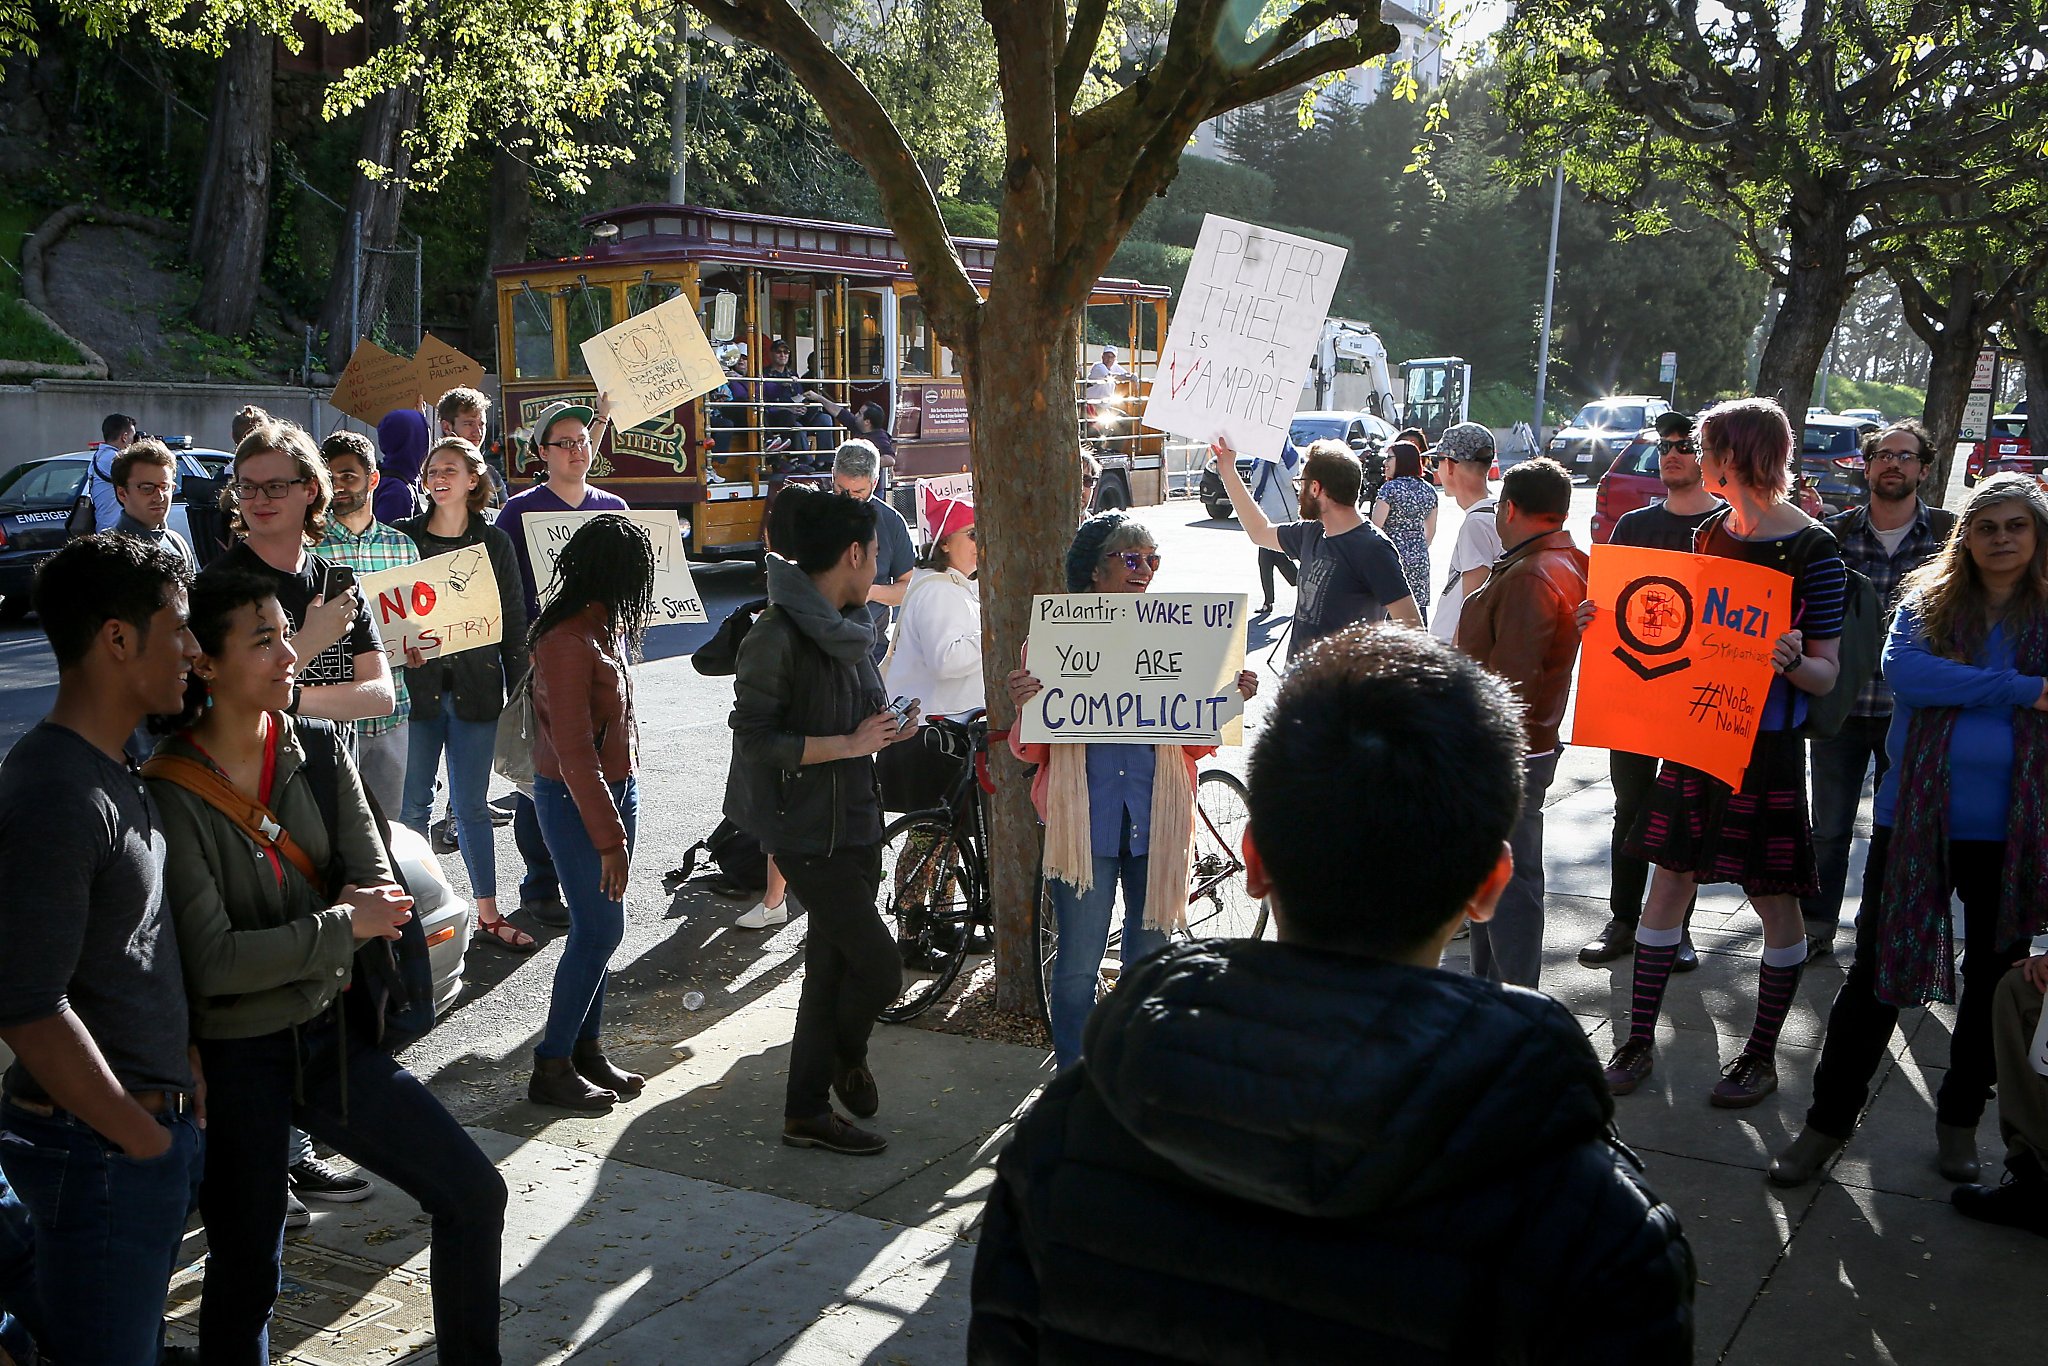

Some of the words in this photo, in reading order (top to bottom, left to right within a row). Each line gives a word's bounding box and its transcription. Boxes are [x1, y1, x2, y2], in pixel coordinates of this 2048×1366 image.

[1211, 230, 1324, 304] PETER
[1200, 283, 1290, 348] THIEL
[427, 355, 454, 368] ICE
[1189, 332, 1208, 349] IS
[1261, 350, 1275, 368] A
[430, 365, 470, 380] PALANTIR
[644, 378, 690, 405] MORDOR
[1170, 351, 1295, 429] VAMPIRE
[616, 432, 676, 454] STREETS
[547, 525, 570, 541] NO
[379, 581, 436, 624] NO
[1041, 597, 1126, 621] Palantir:
[1135, 600, 1192, 624] WAKE
[1203, 601, 1234, 628] UP!
[1056, 645, 1100, 672] YOU
[1135, 649, 1183, 675] ARE
[1042, 688, 1228, 731] COMPLICIT
